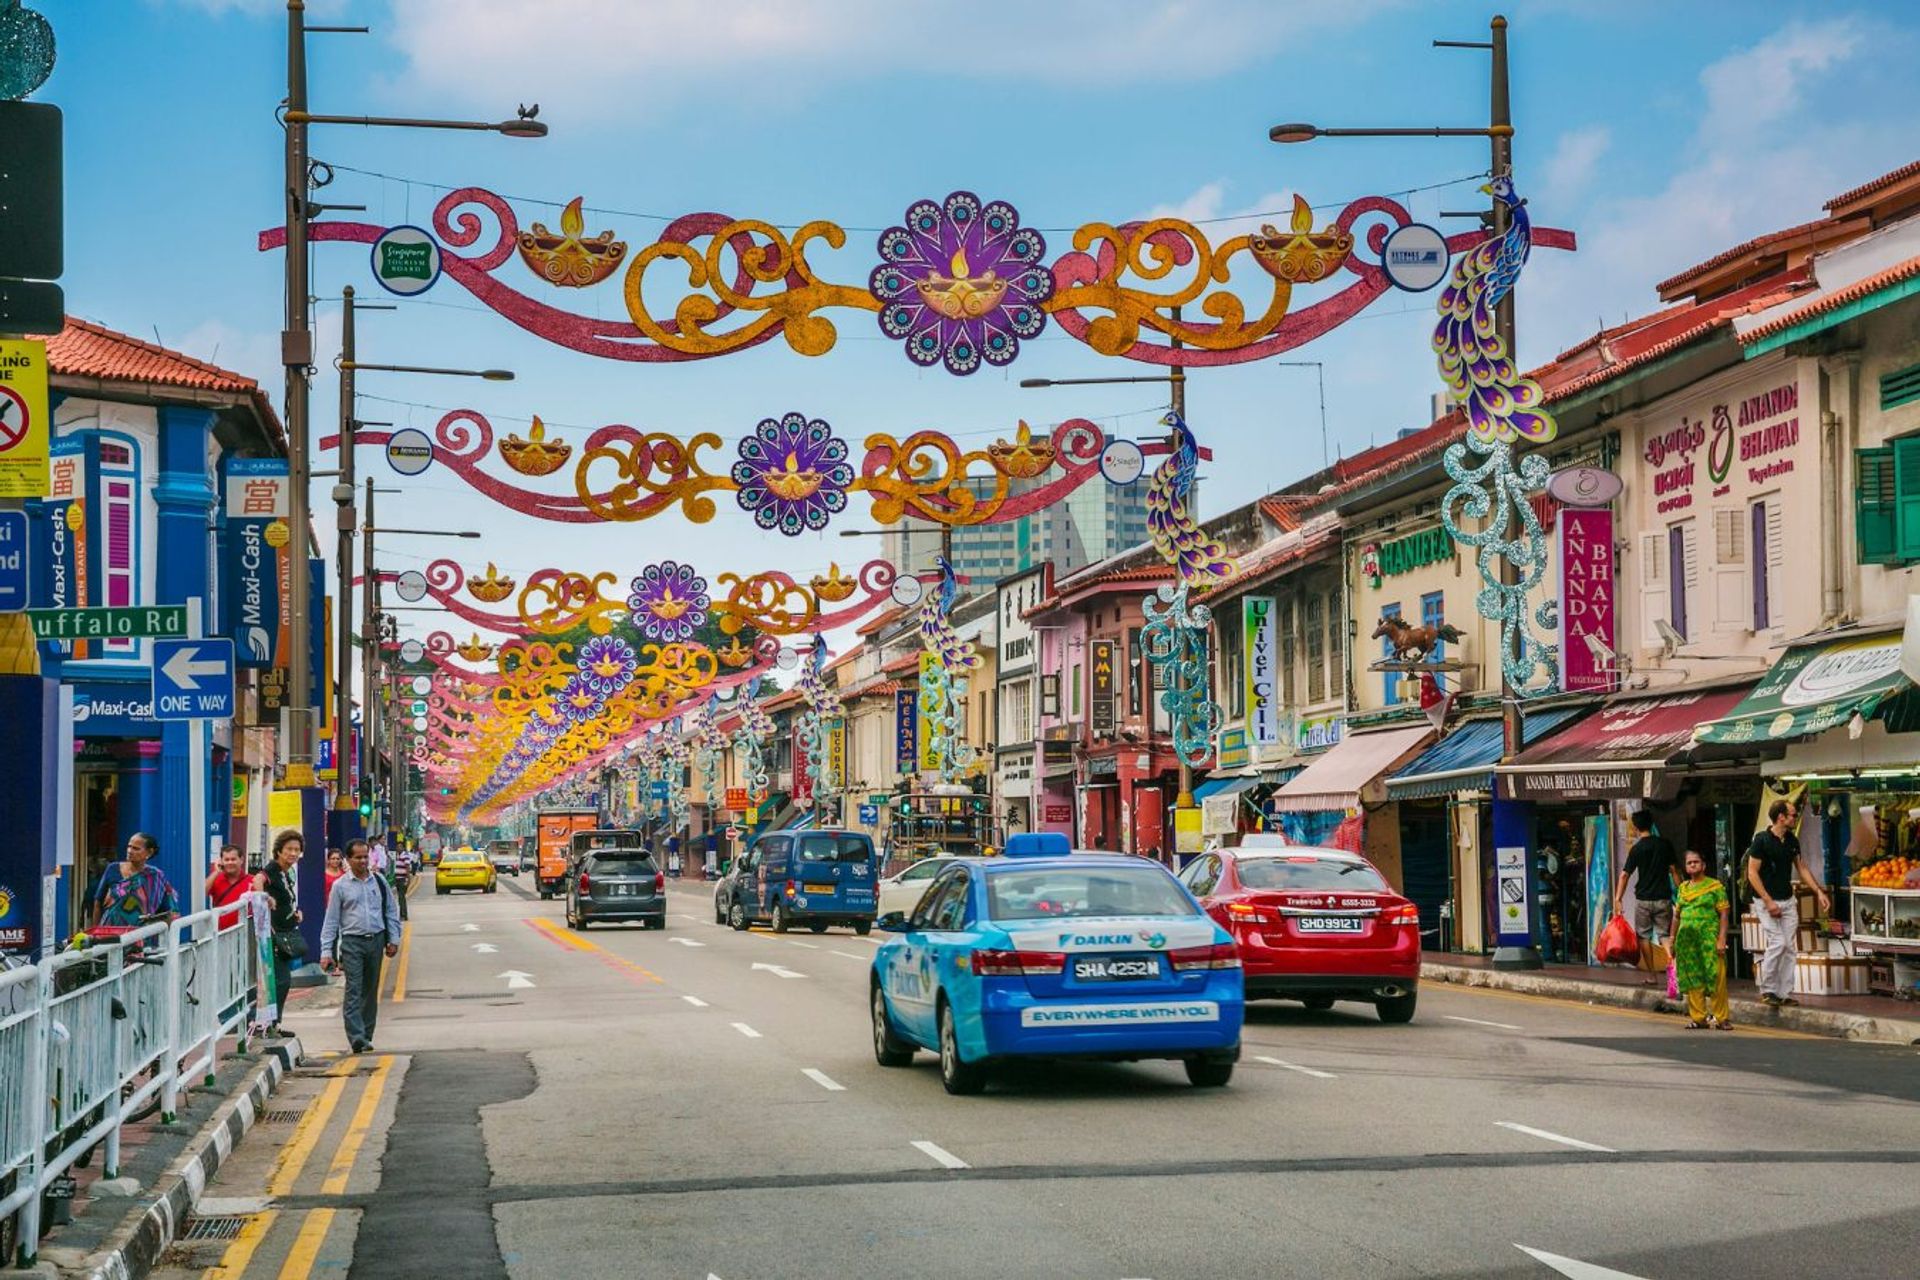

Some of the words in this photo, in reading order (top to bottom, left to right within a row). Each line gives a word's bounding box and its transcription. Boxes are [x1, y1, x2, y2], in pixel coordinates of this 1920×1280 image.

[241, 524, 260, 624] Maxi-Cash
[1568, 519, 1588, 637] ANANDA
[280, 593, 290, 626] OPEN
[38, 611, 132, 636] uffalo
[146, 610, 179, 633] Rd
[1251, 600, 1269, 677] Univer
[1094, 645, 1111, 688] GMT
[160, 695, 191, 713] ONE
[199, 694, 227, 711] WAY
[1252, 682, 1271, 740] Cell
[1525, 774, 1554, 790] ANANDA
[1554, 774, 1585, 789] BHAVAN
[1585, 773, 1632, 789] VEGETARIAN
[1301, 918, 1323, 929] SHD
[1325, 918, 1351, 929] 9912
[1074, 934, 1133, 946] DAIKIN
[1075, 963, 1108, 978] SHA
[1032, 1009, 1138, 1021] EVERYWHERE
[1141, 1008, 1176, 1018] WITH
[1180, 1006, 1209, 1016] YOU
